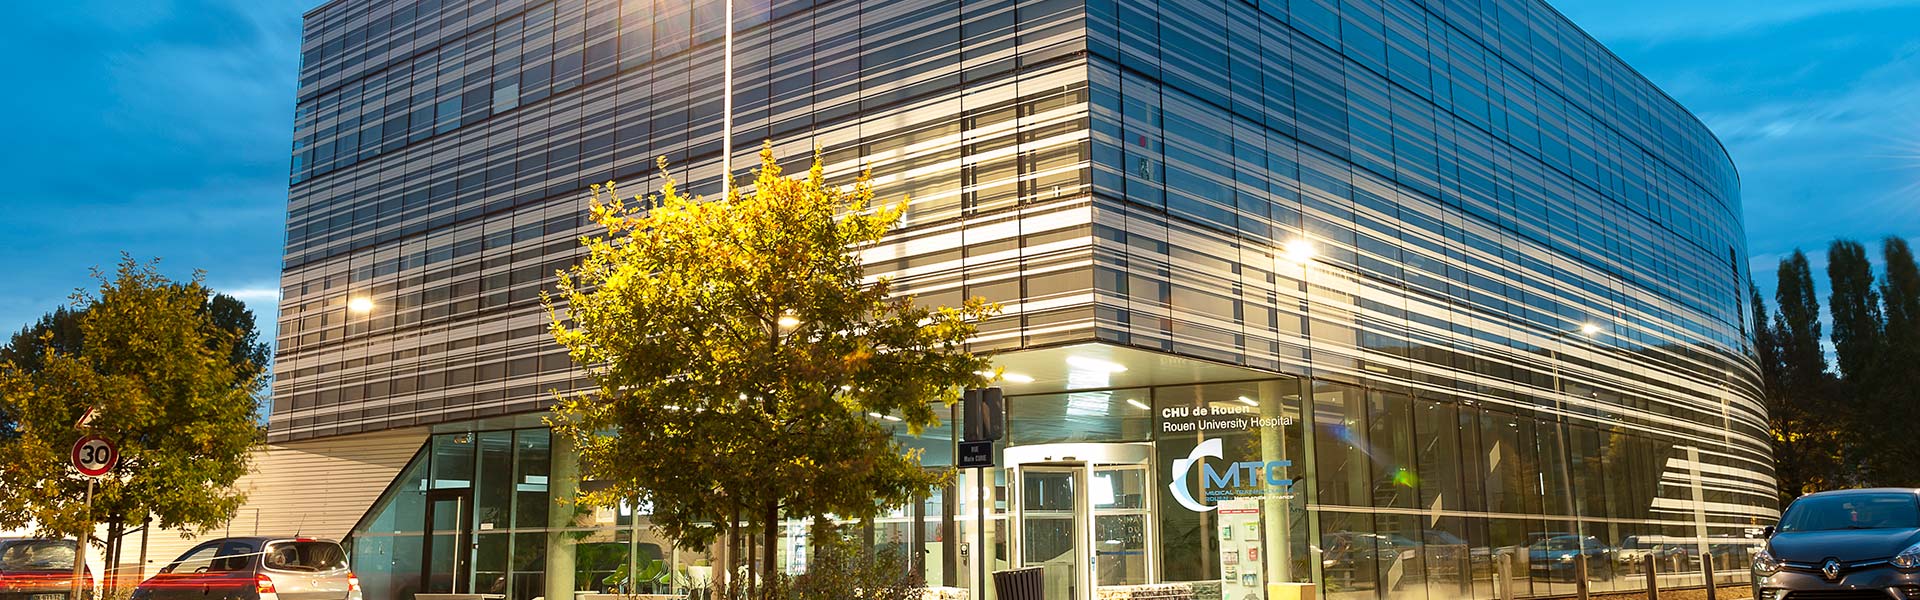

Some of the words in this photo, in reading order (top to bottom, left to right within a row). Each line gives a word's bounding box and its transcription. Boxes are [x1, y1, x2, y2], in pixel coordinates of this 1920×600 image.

[1162, 406, 1189, 418] CHU
[1192, 405, 1208, 417] de
[1211, 405, 1250, 416] Rouen
[1163, 421, 1196, 432] Rouen
[1198, 417, 1248, 430] University
[1250, 415, 1293, 429] Hospital
[80, 445, 110, 464] 30
[1203, 460, 1292, 489] MTC
